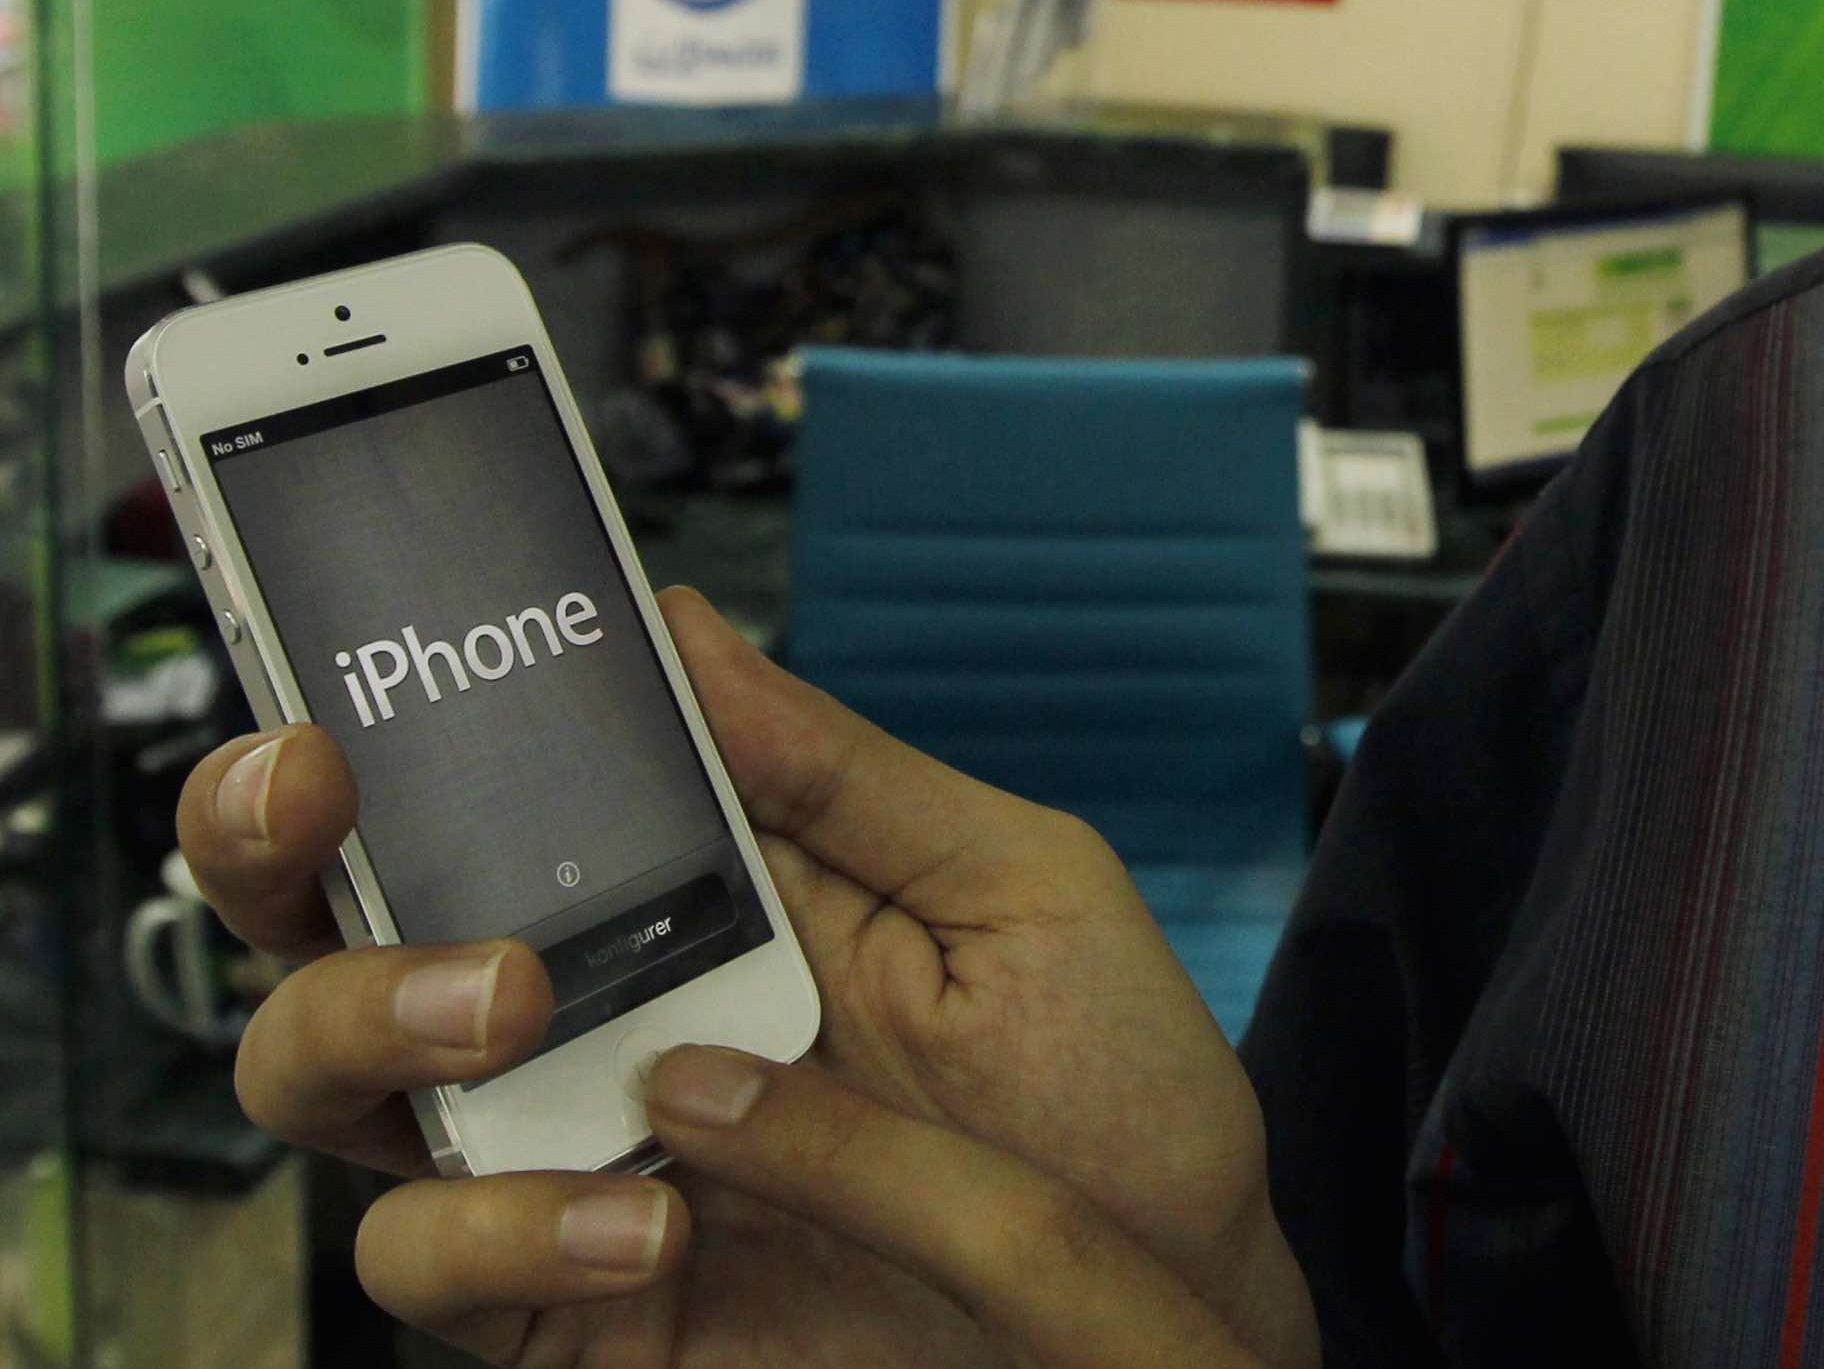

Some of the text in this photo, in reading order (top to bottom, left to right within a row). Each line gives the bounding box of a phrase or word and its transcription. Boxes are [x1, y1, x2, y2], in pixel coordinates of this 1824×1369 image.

[211, 430, 264, 456] No SIM
[334, 591, 605, 729] iPhone
[583, 916, 673, 969] konfigurer
